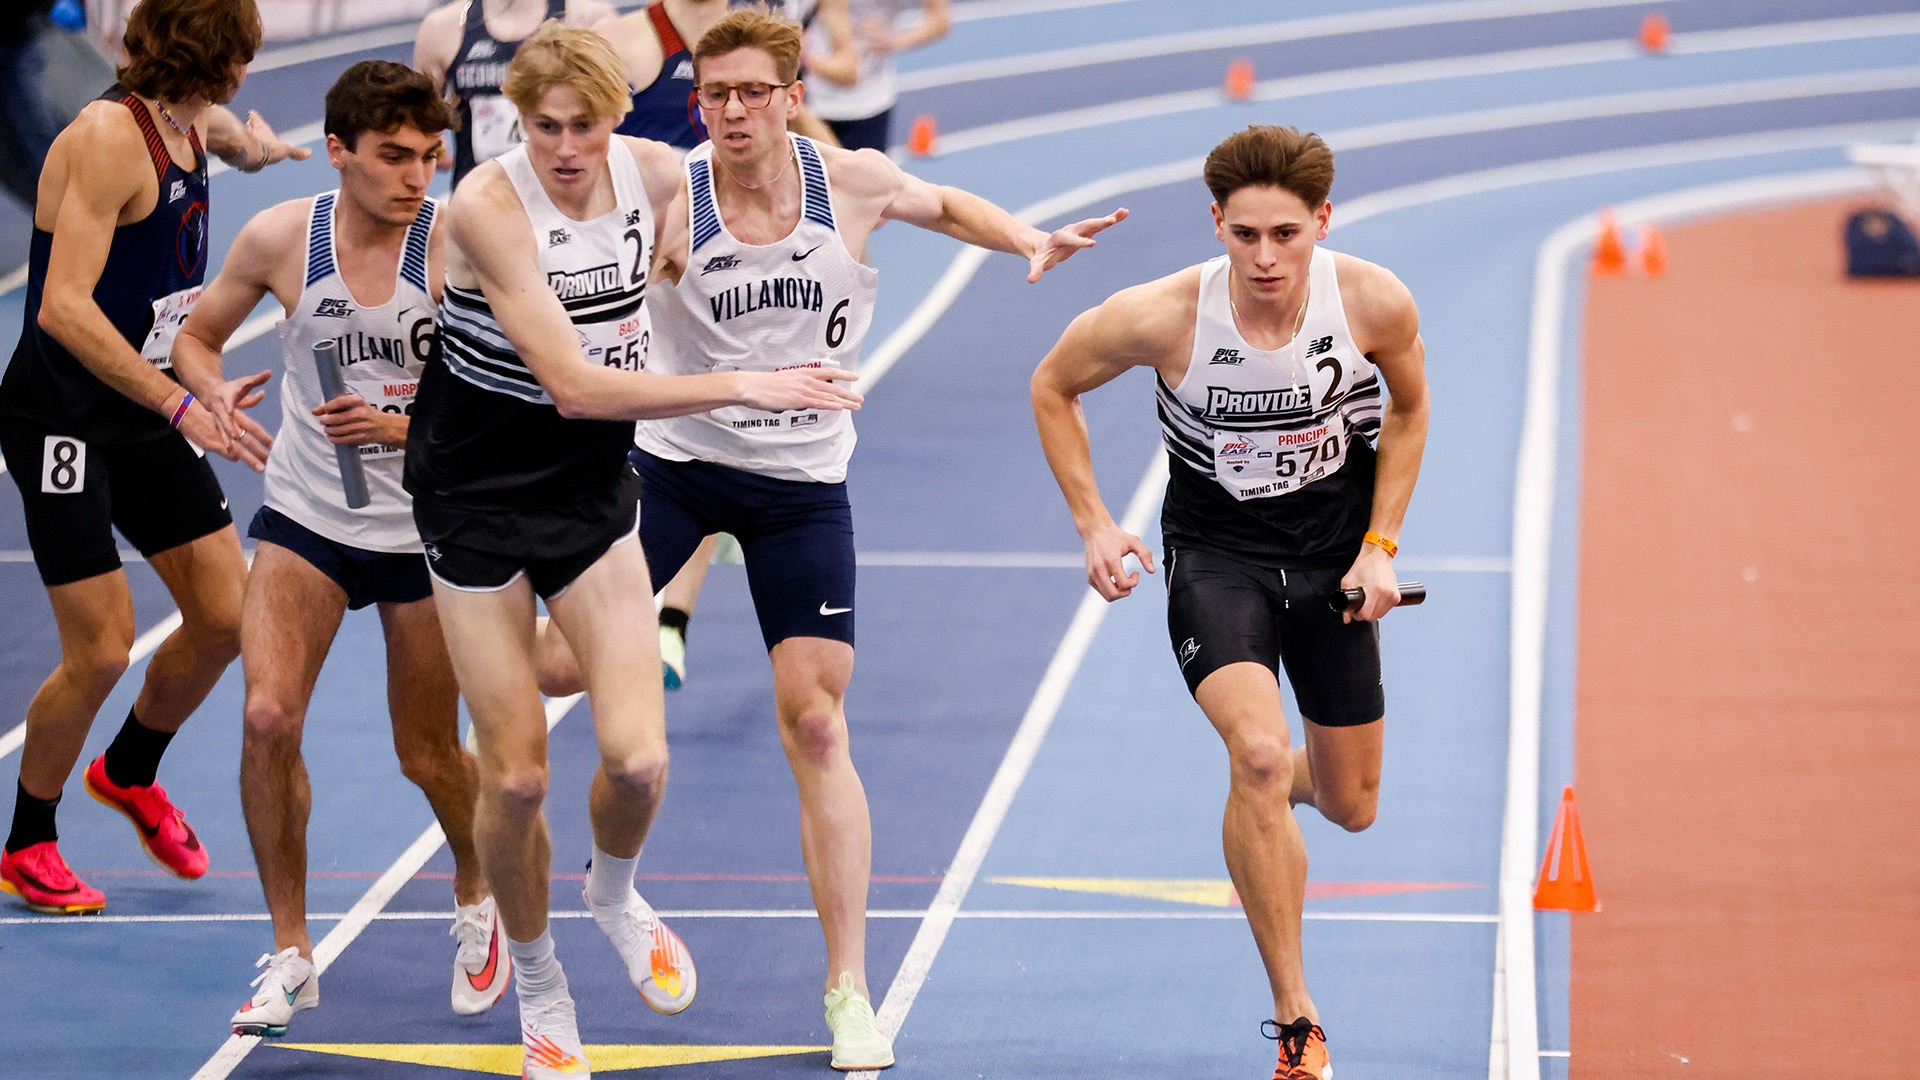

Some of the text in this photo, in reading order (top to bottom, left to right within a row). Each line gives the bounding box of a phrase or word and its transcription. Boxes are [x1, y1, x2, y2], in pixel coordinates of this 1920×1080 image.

[623, 228, 645, 285] 2
[703, 260, 742, 272] EAST
[709, 254, 736, 264] BIG
[318, 298, 349, 308] BIG
[709, 277, 824, 323] VILLANOVA
[314, 308, 355, 317] EAST
[619, 318, 640, 337] BAC
[826, 299, 850, 349] 6
[410, 317, 435, 362] 6
[331, 331, 405, 368] ILLANO
[1215, 348, 1240, 357] BIG
[1211, 355, 1246, 364] EAST
[383, 383, 420, 397] MURP
[1315, 356, 1345, 407] 2
[732, 420, 762, 429] TIMING
[763, 418, 780, 428] TAG
[1278, 425, 1329, 446] PRINCIPE
[51, 441, 78, 490] 8
[1275, 435, 1340, 477] 570
[1239, 480, 1290, 497] TIMING TAG
